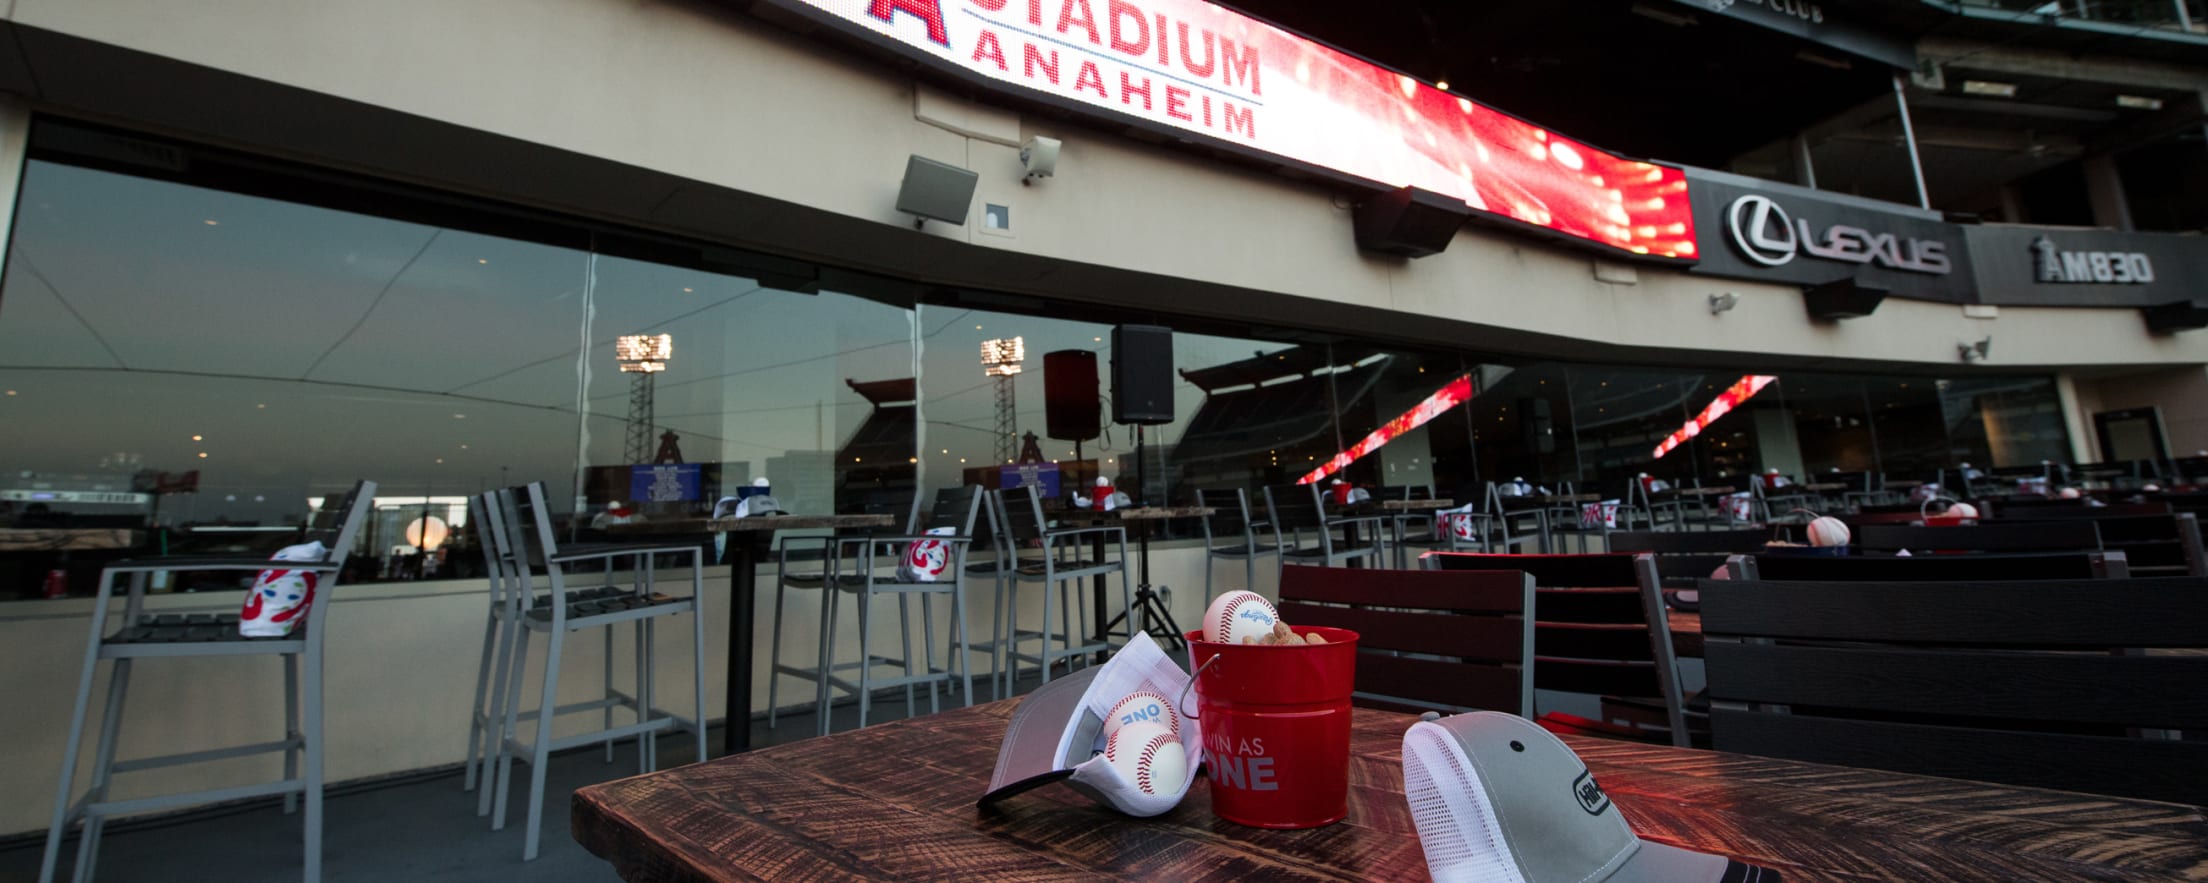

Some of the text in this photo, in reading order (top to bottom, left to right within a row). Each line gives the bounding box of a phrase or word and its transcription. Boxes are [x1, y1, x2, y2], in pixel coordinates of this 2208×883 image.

[969, 0, 1262, 96] ADIUM
[972, 29, 1256, 139] ANAHEIM
[1798, 218, 1952, 275] LEXUS
[1121, 703, 1161, 725] ONE
[1238, 737, 1264, 756] AS
